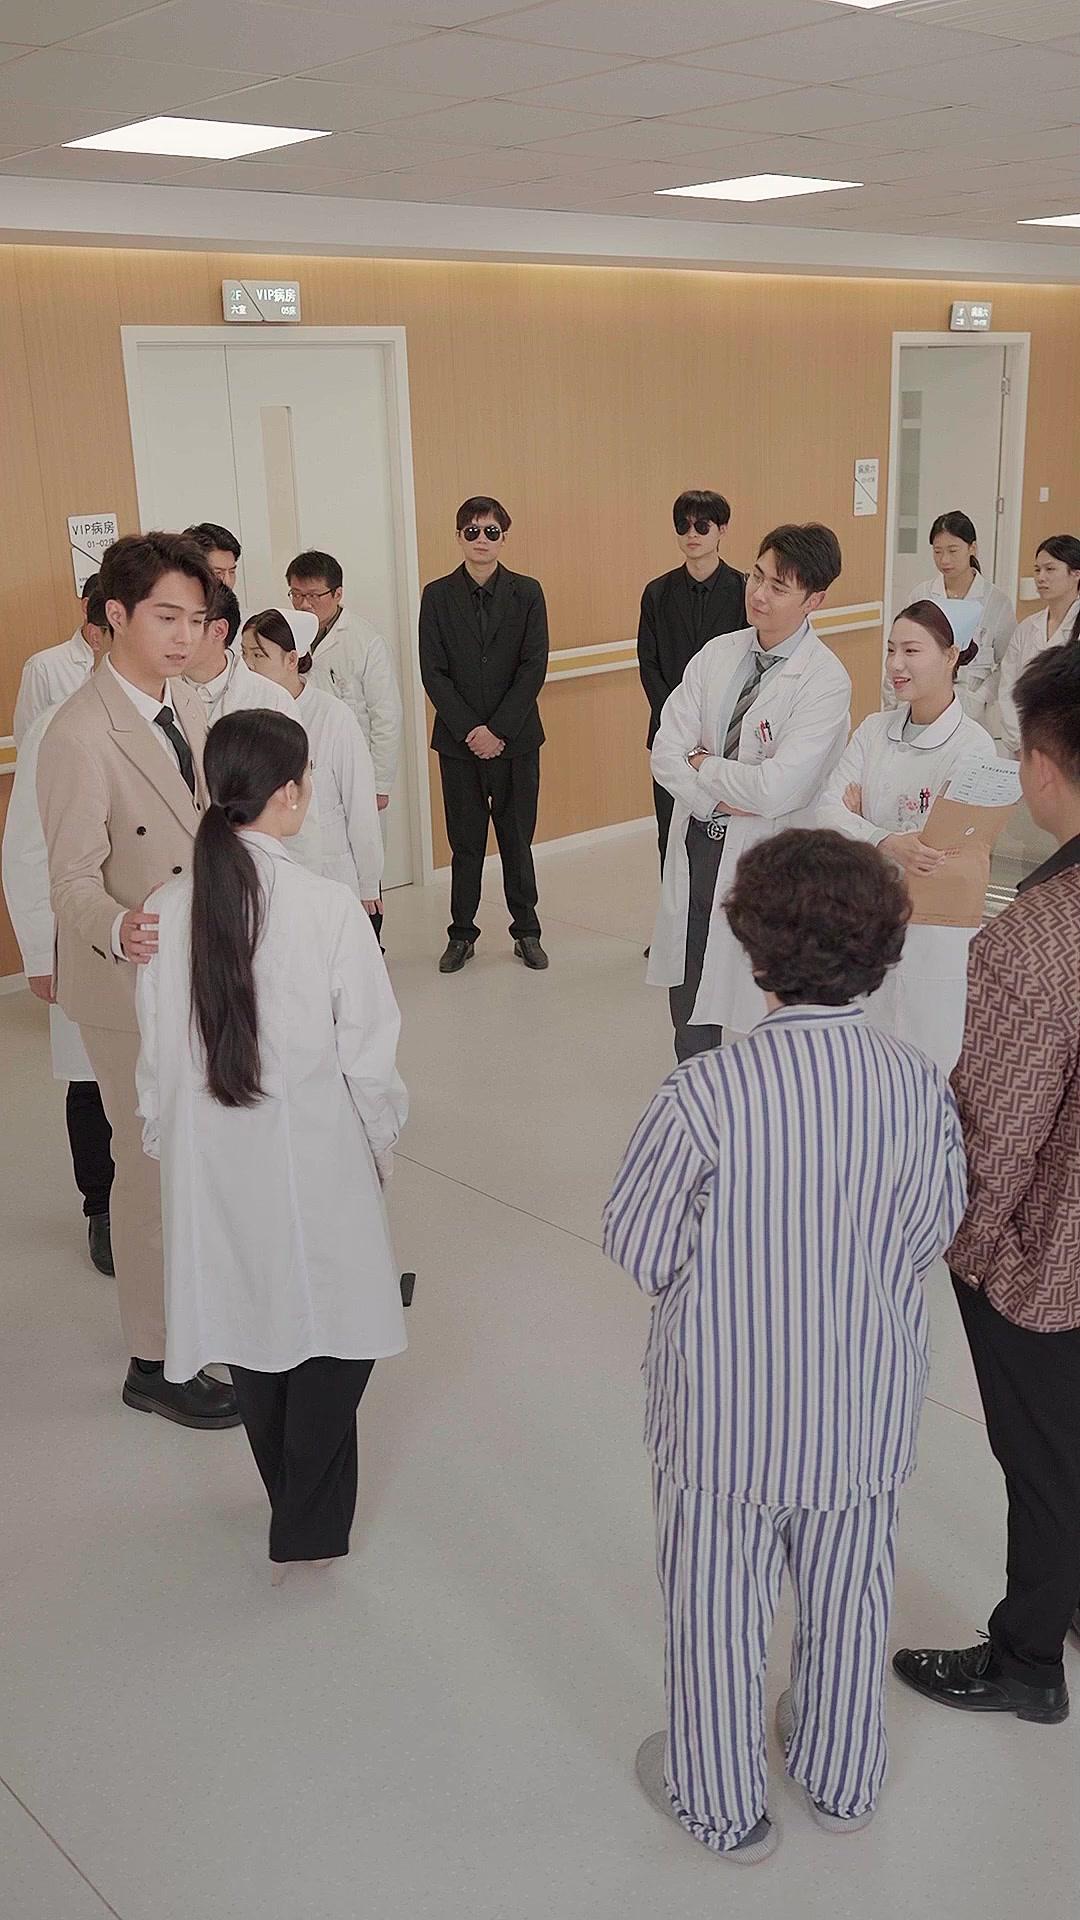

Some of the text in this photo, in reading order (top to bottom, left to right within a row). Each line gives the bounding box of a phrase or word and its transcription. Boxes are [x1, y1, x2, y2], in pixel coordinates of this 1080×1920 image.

[230, 288, 296, 303] 2F VIP病房
[72, 521, 115, 536] VIP病房
